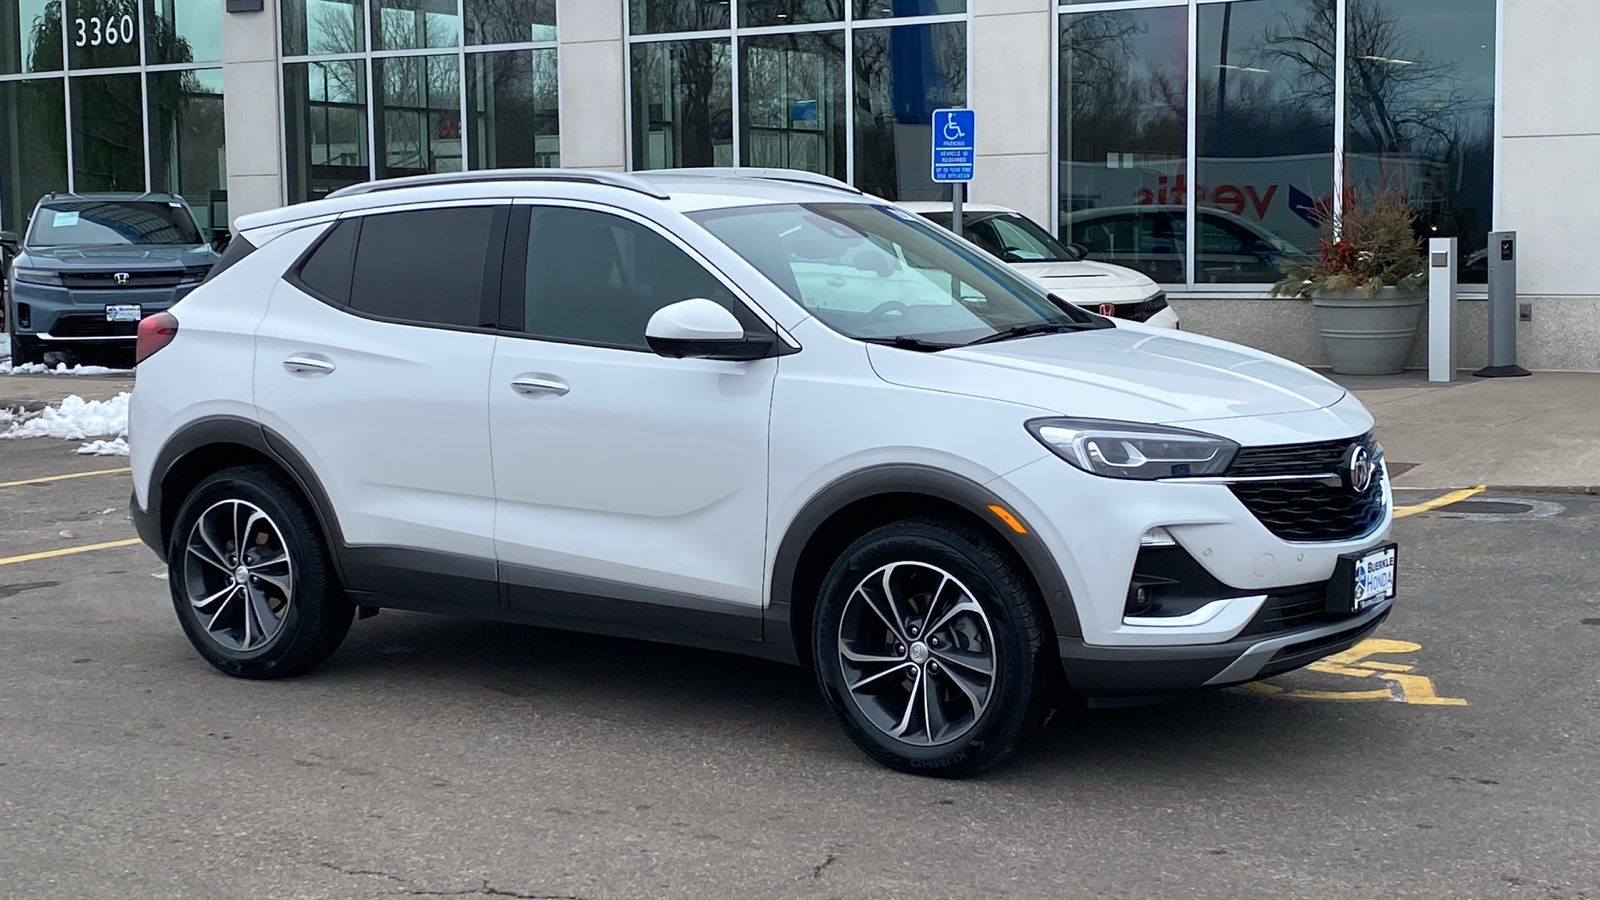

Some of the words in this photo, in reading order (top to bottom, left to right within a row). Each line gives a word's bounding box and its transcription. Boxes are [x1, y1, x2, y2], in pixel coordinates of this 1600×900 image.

[75, 14, 134, 47] 3360
[1367, 557, 1394, 574] BUERKLE
[1366, 571, 1393, 593] HONDA
[910, 750, 968, 768] KUMHO
